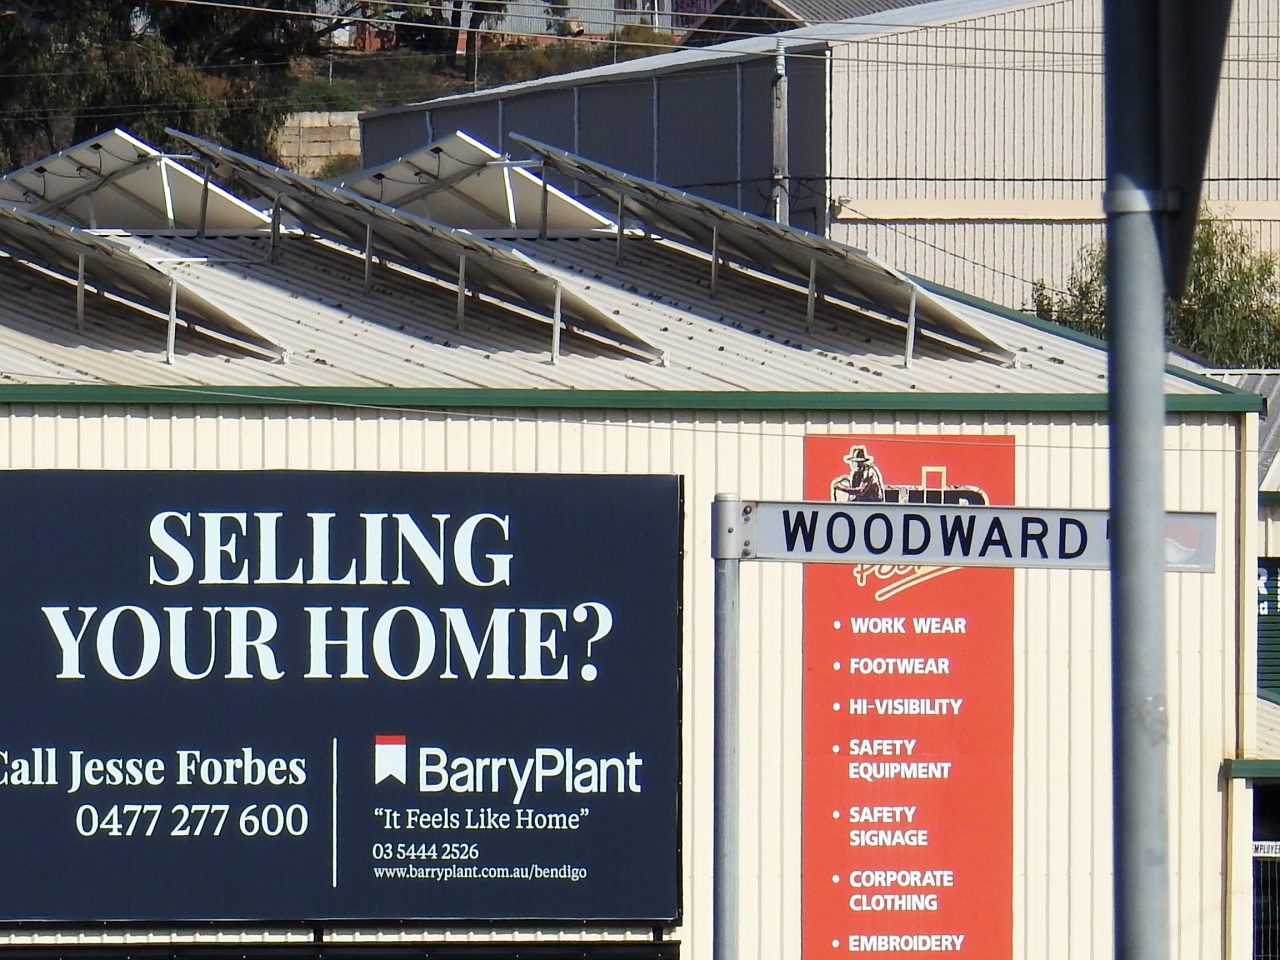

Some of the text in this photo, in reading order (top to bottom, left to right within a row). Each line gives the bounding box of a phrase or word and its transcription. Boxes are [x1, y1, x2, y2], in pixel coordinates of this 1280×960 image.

[782, 509, 1089, 559] WOODWARD
[150, 511, 514, 587] SELLING
[850, 617, 967, 634] WORK WEAR
[41, 602, 613, 682] YOUR HOME?
[850, 657, 950, 675] FOOTWEAR
[849, 698, 963, 715] HI-VISIBILITY
[849, 738, 917, 755] SAFETY
[68, 750, 165, 794] Jesse
[176, 748, 307, 786] Forbes
[419, 747, 643, 805] BarryPlant
[849, 761, 952, 782] EQUIPMENT
[75, 803, 309, 837] 0477 277 600
[405, 807, 460, 829] Feels
[464, 807, 511, 829] Like
[849, 806, 917, 823] SAFETY
[849, 829, 928, 847] SIGNAGE
[372, 843, 479, 860] 03 5444 2526
[373, 863, 587, 882] www.barryplant.com.au/bendigo
[849, 870, 954, 888] CORPORATE
[849, 893, 938, 911] CLOTHING
[848, 934, 965, 952] EMBROIDERY
